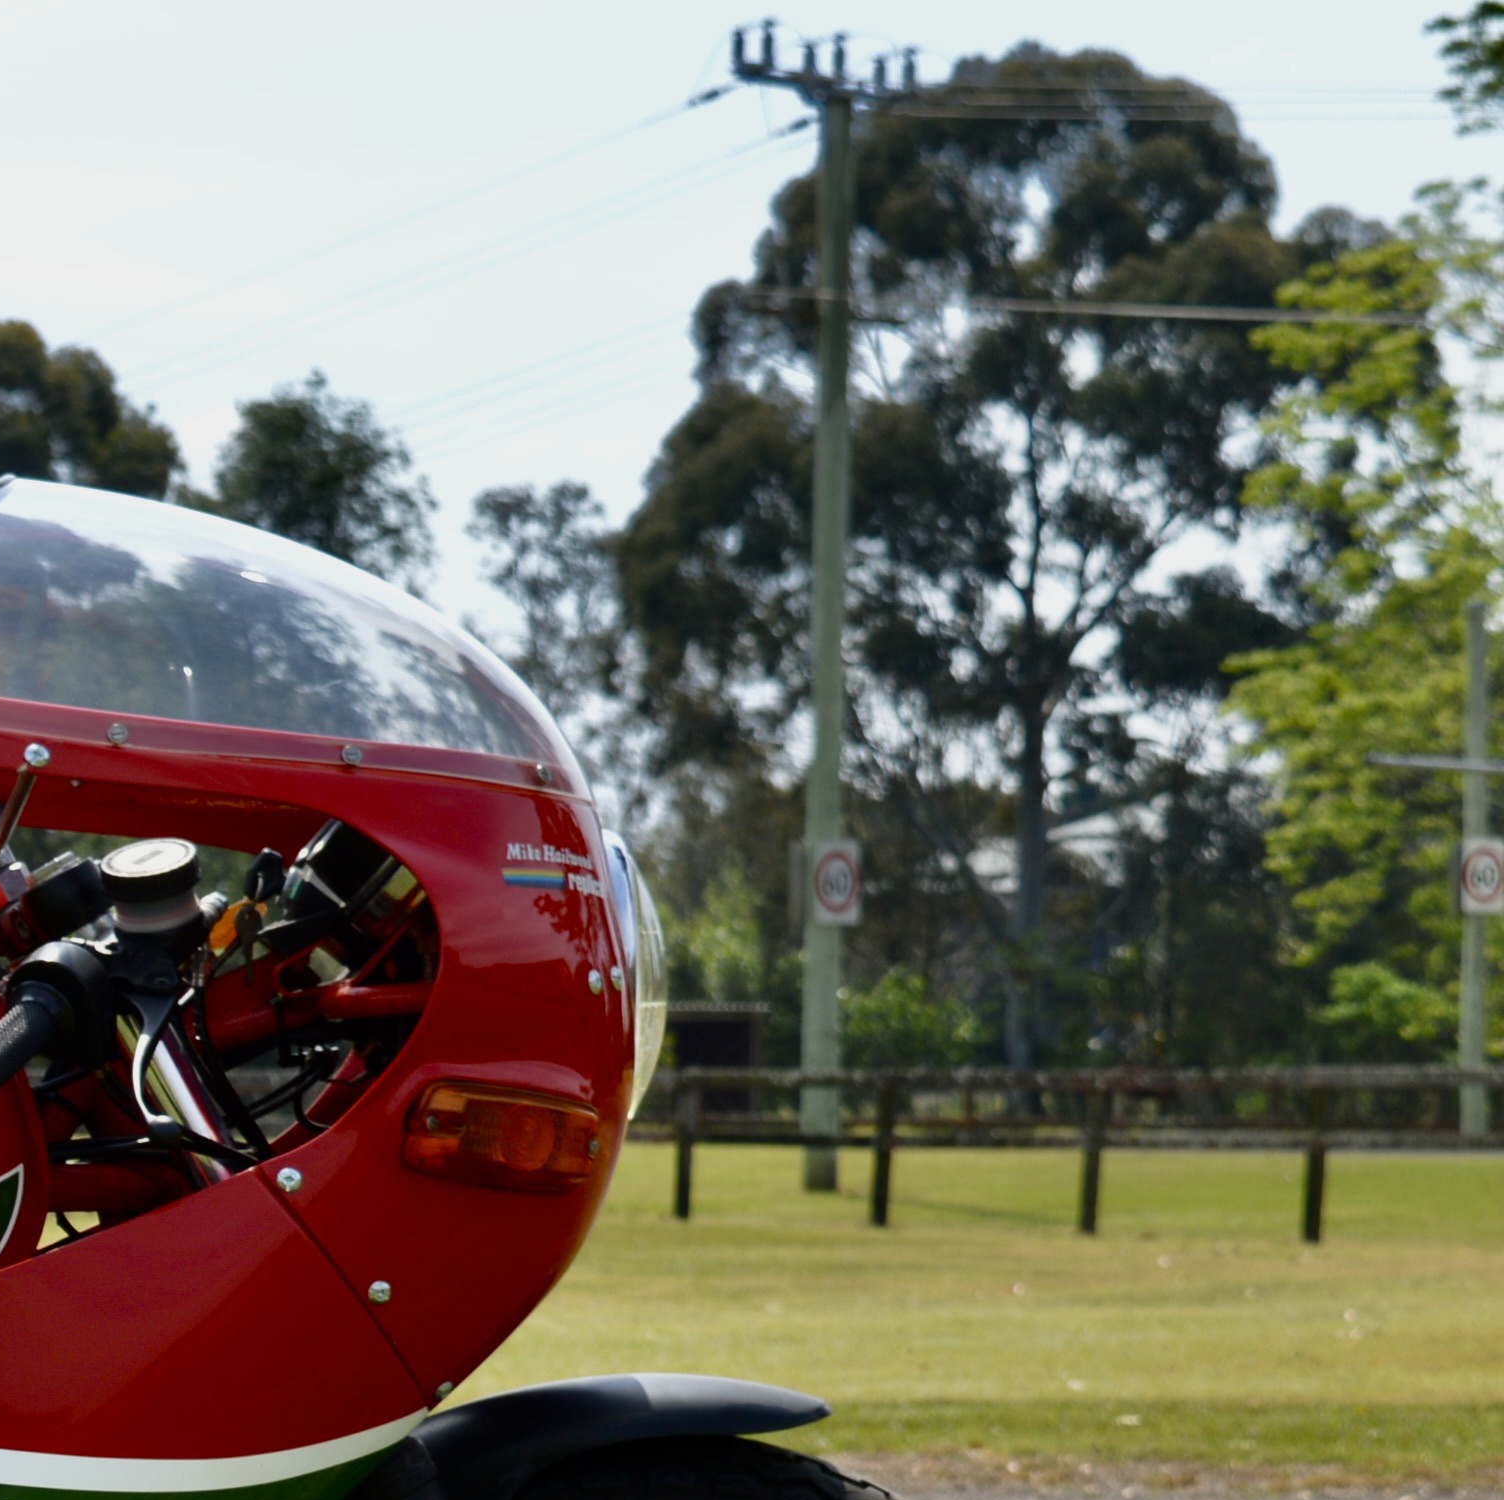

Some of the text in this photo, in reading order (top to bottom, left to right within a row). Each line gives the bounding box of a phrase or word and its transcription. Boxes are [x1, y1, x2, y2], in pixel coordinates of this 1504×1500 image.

[506, 842, 541, 861] Mike
[822, 869, 849, 897] 60
[1471, 864, 1495, 888] 60
